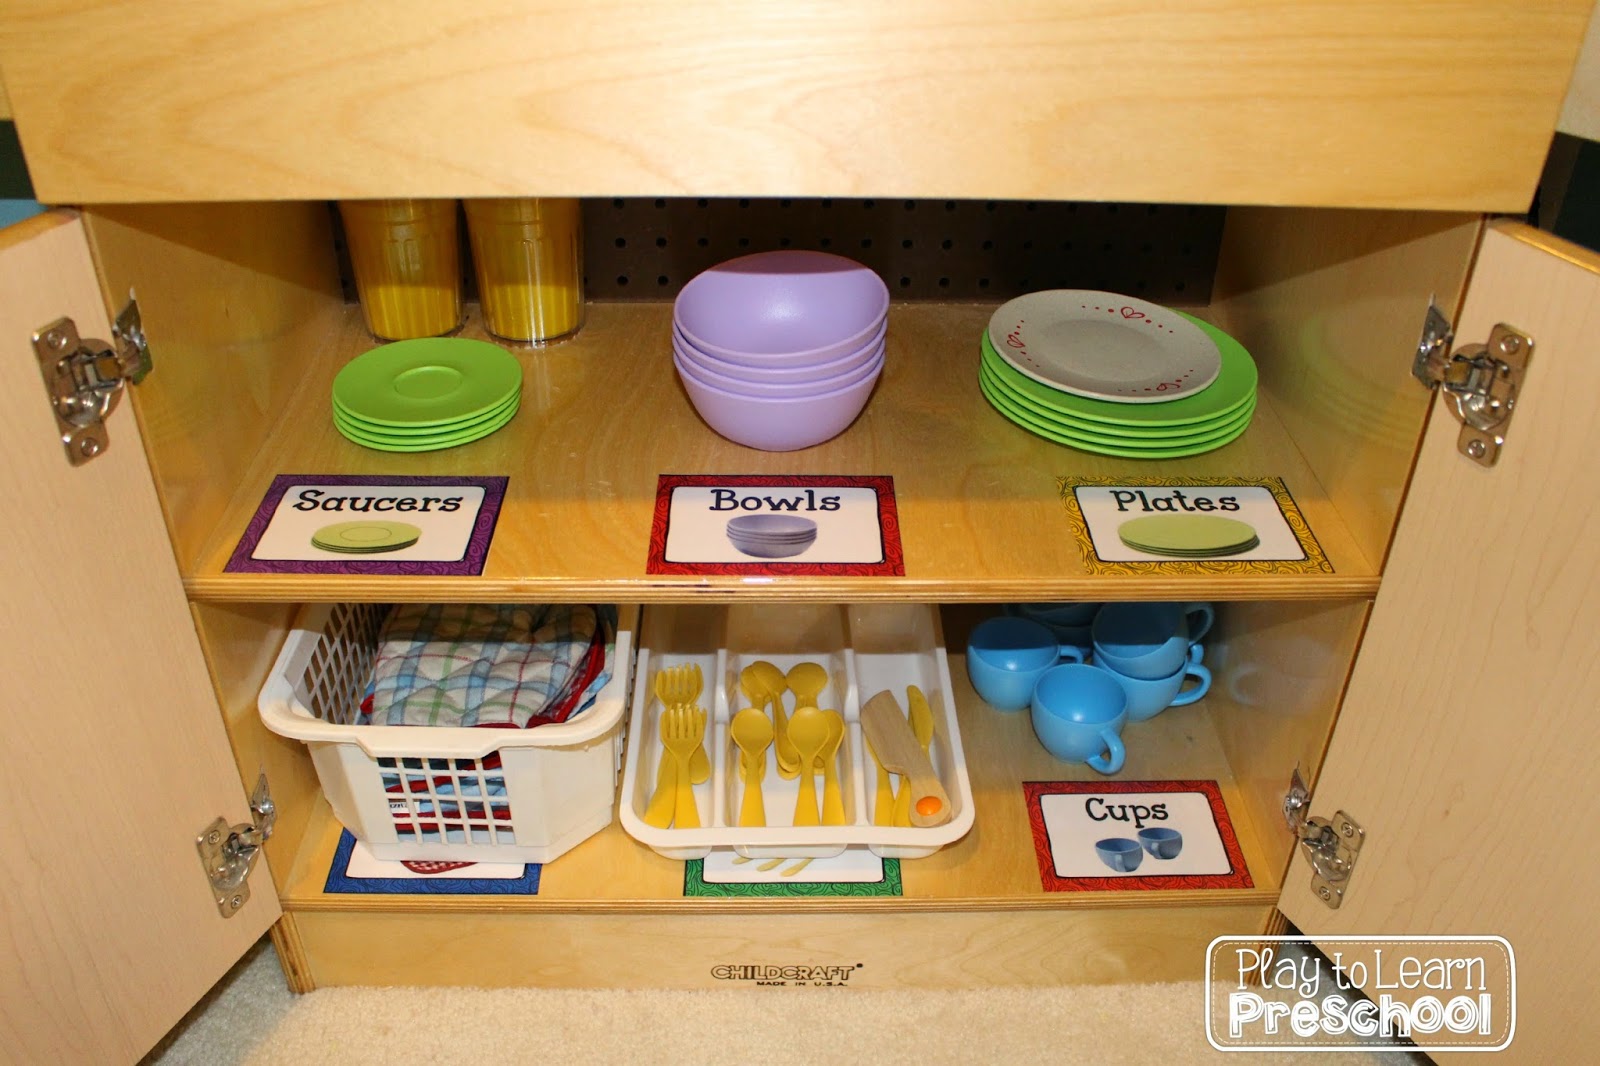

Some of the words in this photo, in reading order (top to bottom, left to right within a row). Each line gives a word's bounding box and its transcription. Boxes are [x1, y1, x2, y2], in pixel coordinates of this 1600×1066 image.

[292, 489, 464, 513] Saucers
[709, 488, 841, 511] Bowls
[1109, 490, 1240, 512] Plates
[1085, 797, 1169, 829] Cups
[710, 964, 856, 981] CHILDCRAFT
